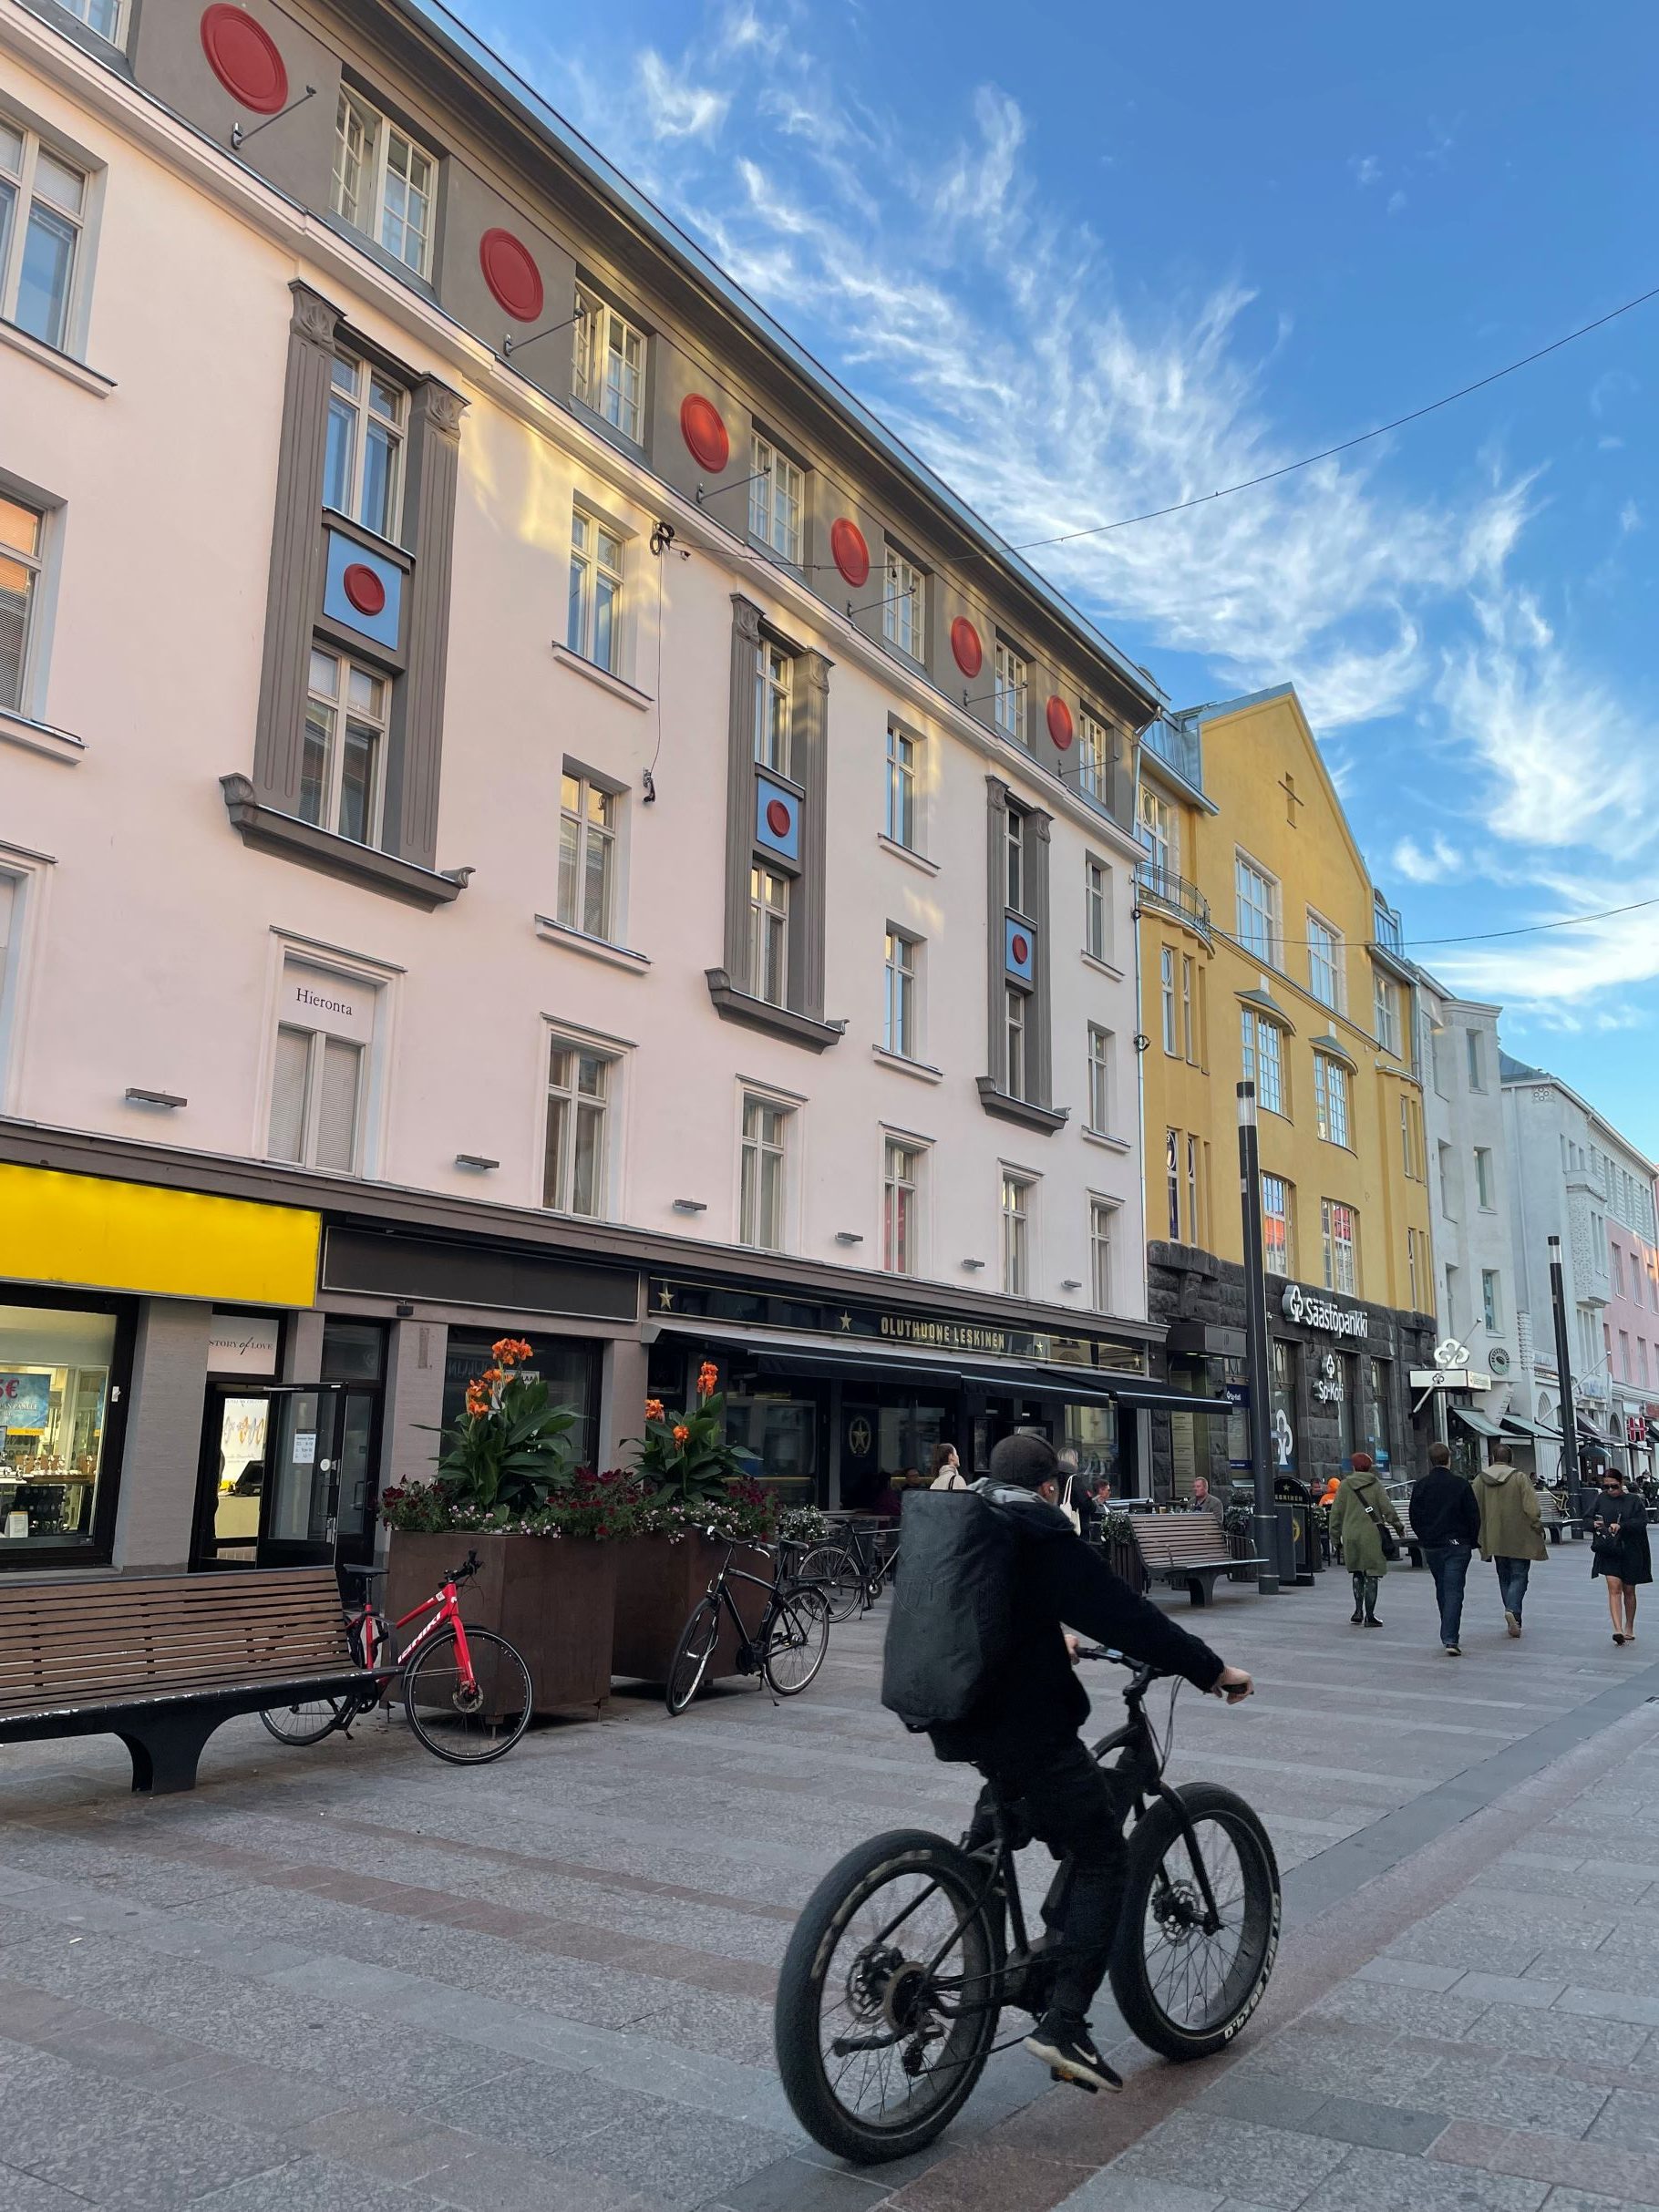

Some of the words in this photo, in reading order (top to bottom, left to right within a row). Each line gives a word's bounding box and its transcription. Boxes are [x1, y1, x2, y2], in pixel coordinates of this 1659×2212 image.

[296, 987, 352, 1015] Hieronta
[1305, 1297, 1367, 1338] Säästöpankki
[239, 1336, 253, 1355] of
[252, 1342, 273, 1350] LOVE
[881, 1316, 950, 1343] OLUTHUONE
[954, 1327, 1005, 1349] LESKINEN
[1318, 1380, 1344, 1404] Sp-Koti
[1275, 1494, 1304, 1502] ESKINEN
[397, 1611, 441, 1664] ISHIKI
